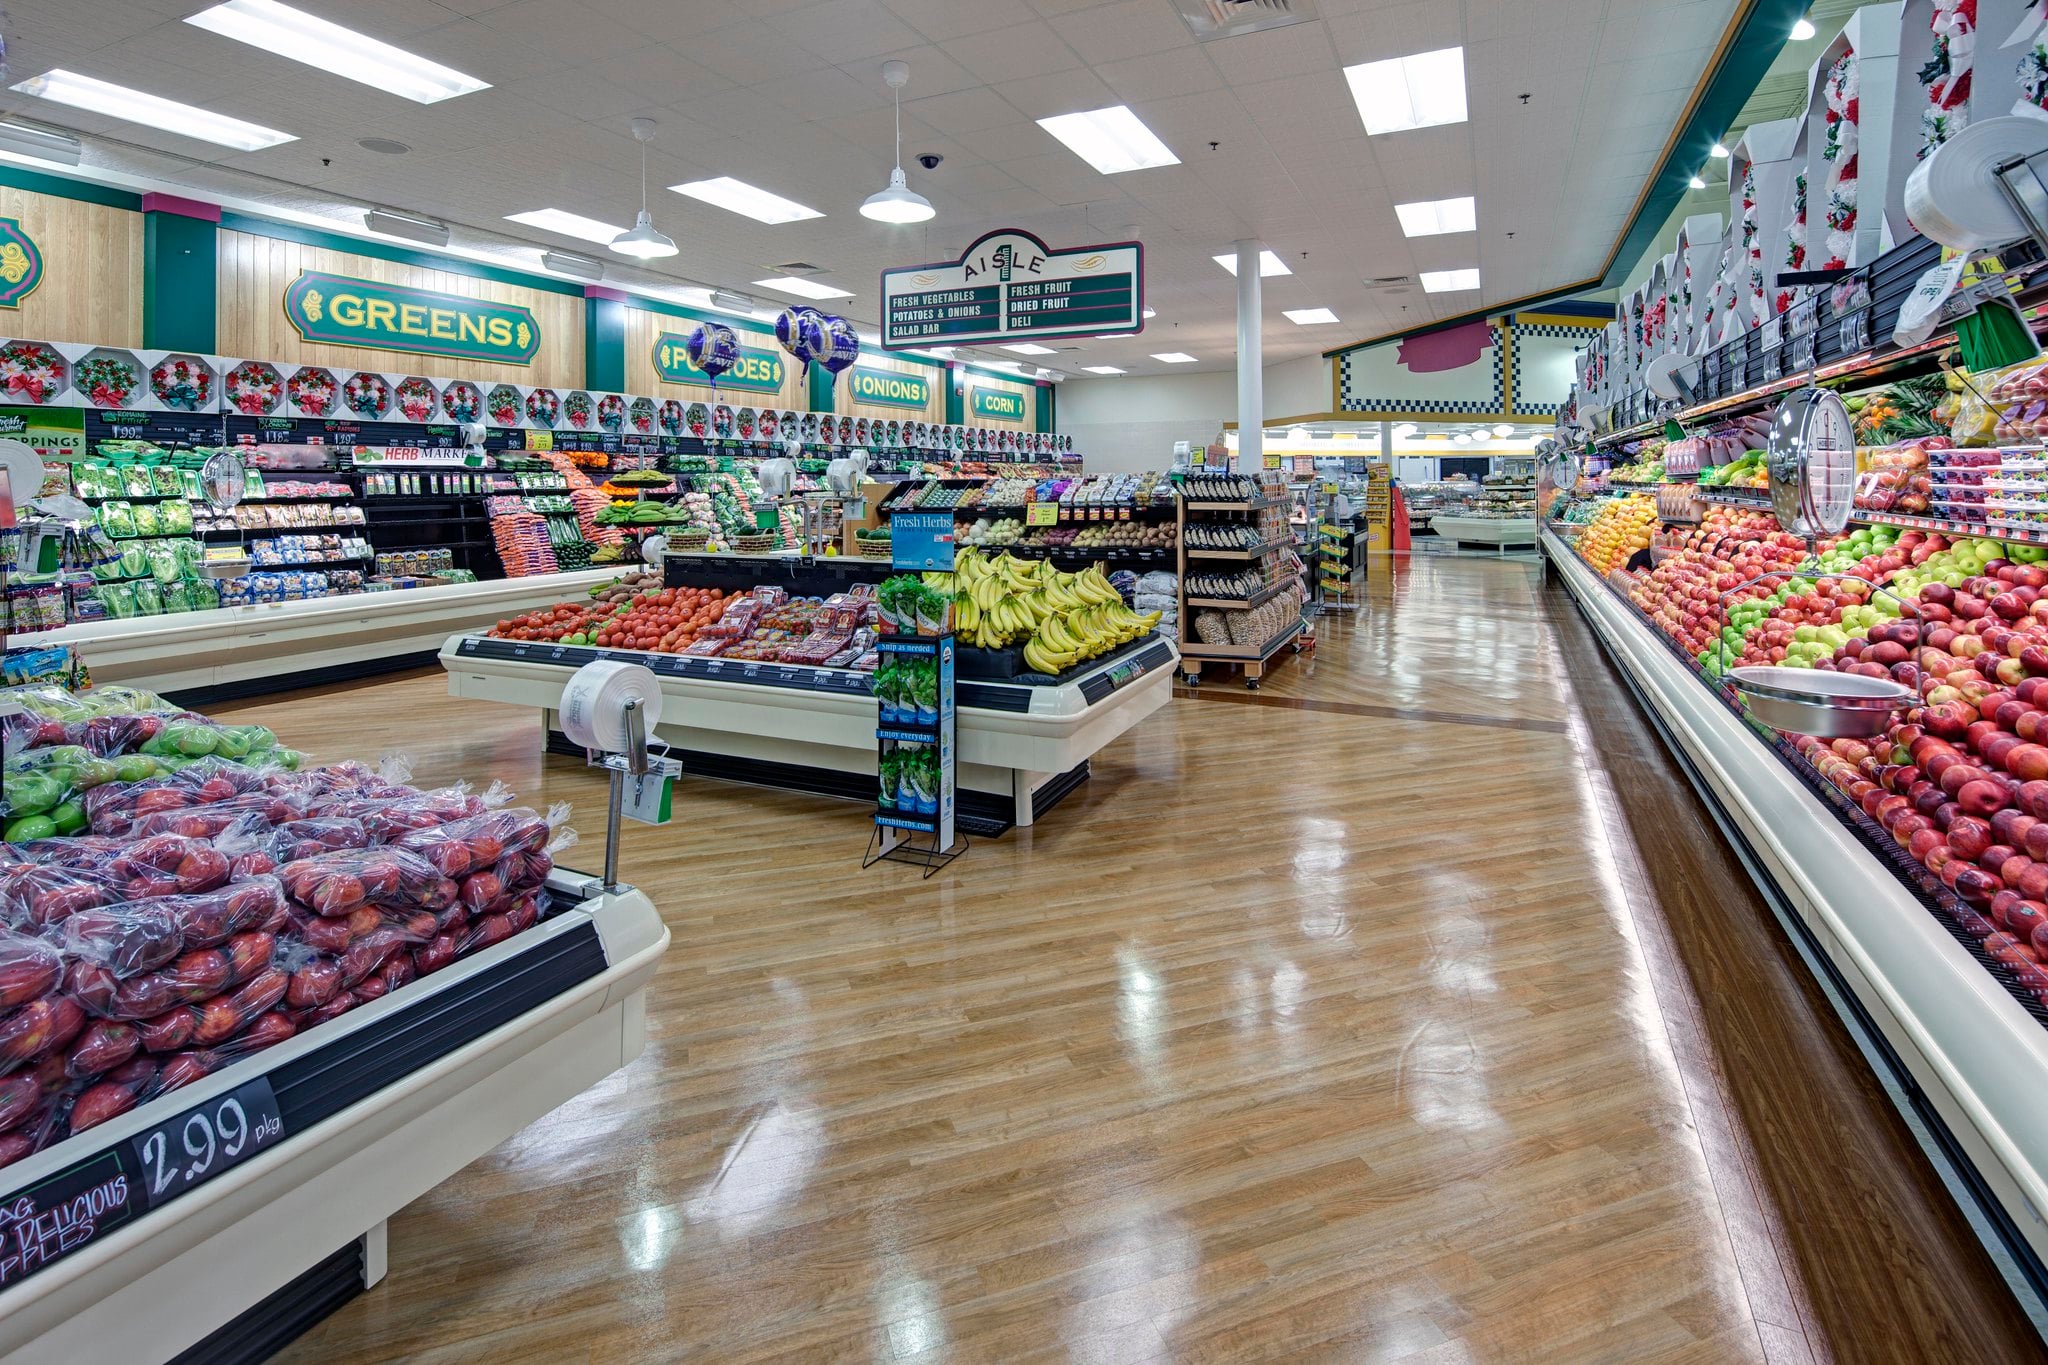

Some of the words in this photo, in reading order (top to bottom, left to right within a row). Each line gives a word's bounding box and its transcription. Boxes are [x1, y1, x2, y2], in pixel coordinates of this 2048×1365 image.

[964, 251, 1046, 282] AISLE
[996, 244, 1012, 282] 1
[1011, 285, 1041, 297] FRESH
[1045, 281, 1072, 294] FRUIT
[893, 296, 919, 308] FRESH
[922, 291, 975, 305] VEGETABLES
[1011, 300, 1038, 312] DRIED
[1042, 298, 1070, 310] FRUIT
[329, 294, 513, 347] GREENS
[893, 309, 934, 322] POTATOES
[937, 309, 944, 319] &
[948, 305, 981, 317] ONIONS
[1011, 316, 1031, 328] DELI
[893, 324, 919, 337] SALAD
[922, 323, 940, 335] BAR
[673, 346, 771, 381] POOES
[862, 376, 920, 400] ONIONS
[985, 395, 1014, 413] CORN
[384, 447, 420, 461] HERB
[421, 447, 468, 459] MARKE
[894, 515, 920, 528] Fresh
[922, 515, 952, 528] Herbs
[881, 643, 897, 652] Snip
[907, 645, 931, 653] needed
[879, 730, 899, 740] Enjoy
[900, 732, 931, 742] everyday
[142, 1097, 248, 1195] 2.99
[254, 1113, 281, 1143] pkg
[0, 1197, 36, 1225] AG
[14, 1174, 129, 1252] DELICIOUS
[0, 1218, 97, 1282] PPLES
